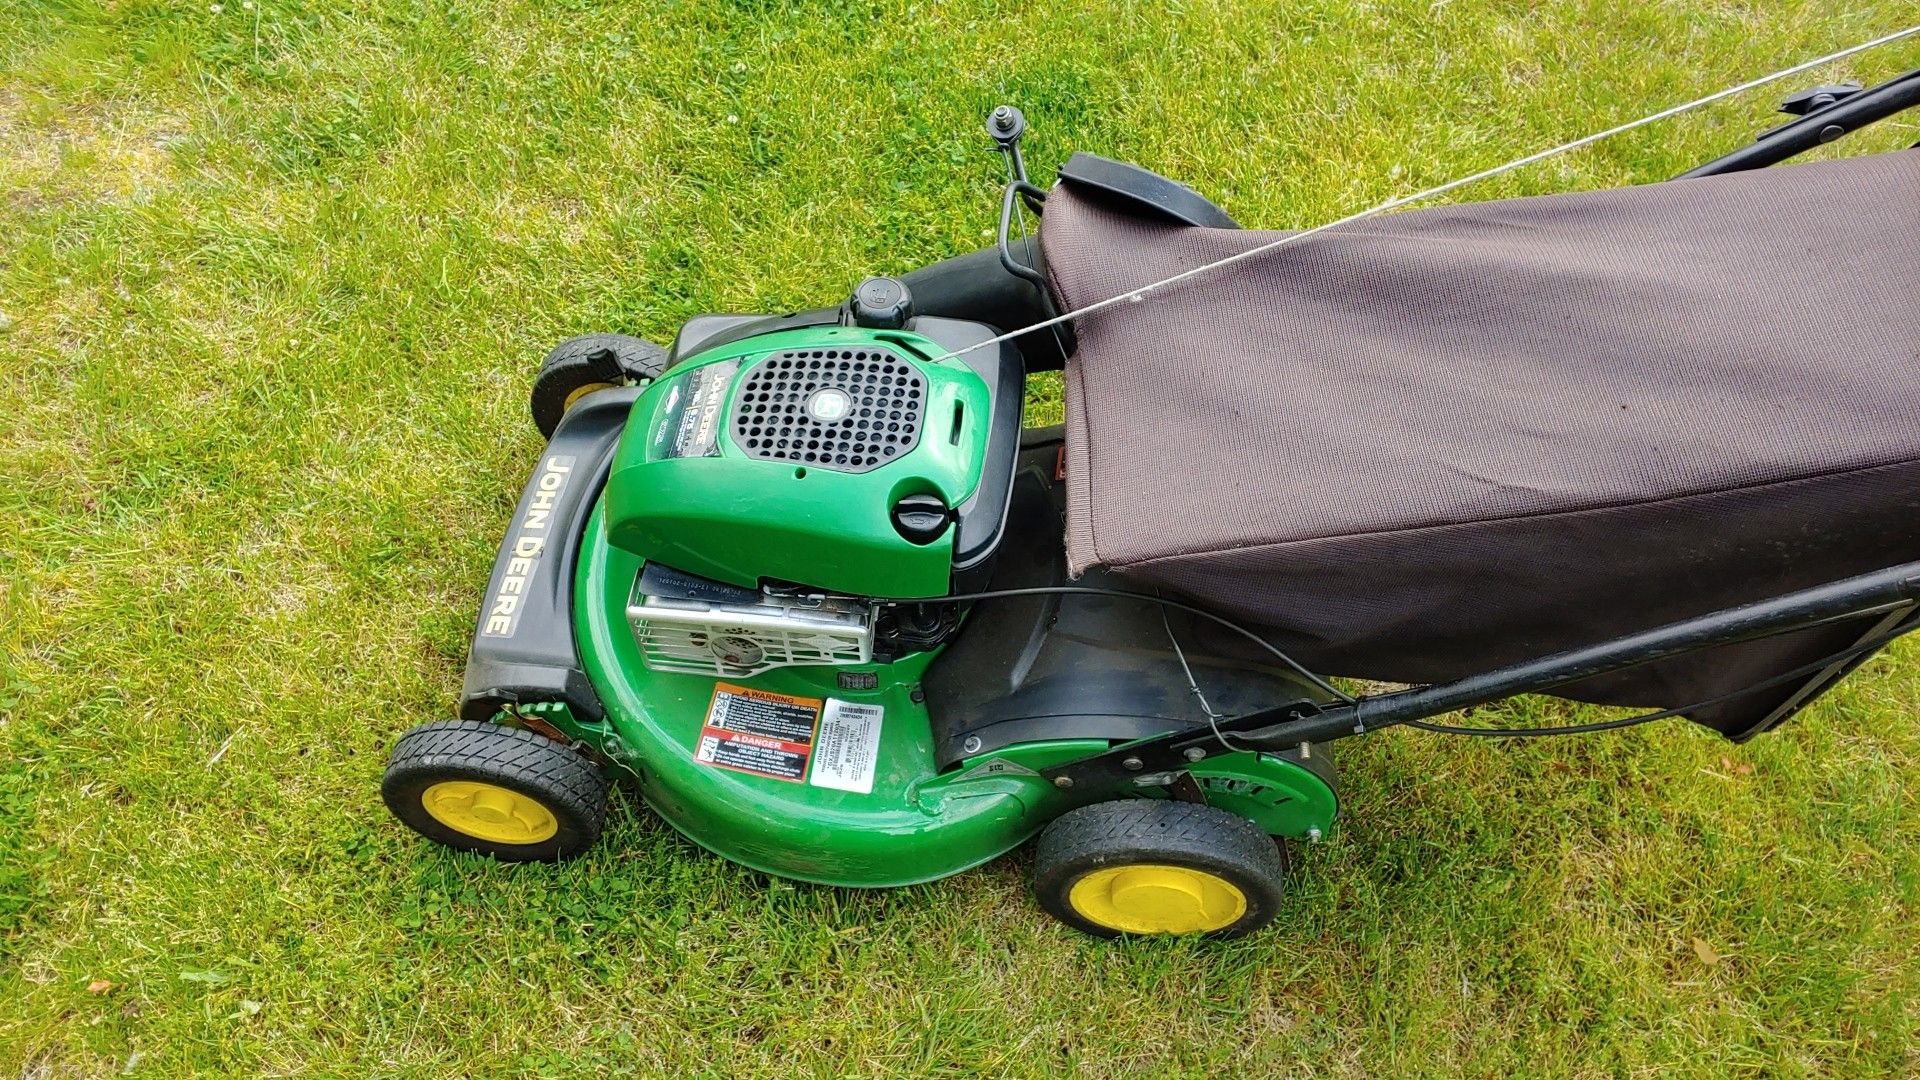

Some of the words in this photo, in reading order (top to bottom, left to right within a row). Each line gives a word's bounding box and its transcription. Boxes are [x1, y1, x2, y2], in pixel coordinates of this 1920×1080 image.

[706, 374, 725, 405] JOHN
[695, 406, 717, 445] DEERE
[525, 457, 569, 529] JOHN
[485, 537, 544, 635] DEERE
[749, 697, 771, 705] SERIOUS
[751, 691, 794, 703] WARNING
[724, 741, 760, 751] AMPUTATION
[773, 750, 798, 758] THROWN
[740, 737, 781, 749] DANGER
[738, 748, 760, 757] OBJECT
[761, 753, 784, 761] HAZARD
[816, 745, 824, 764] JOHN
